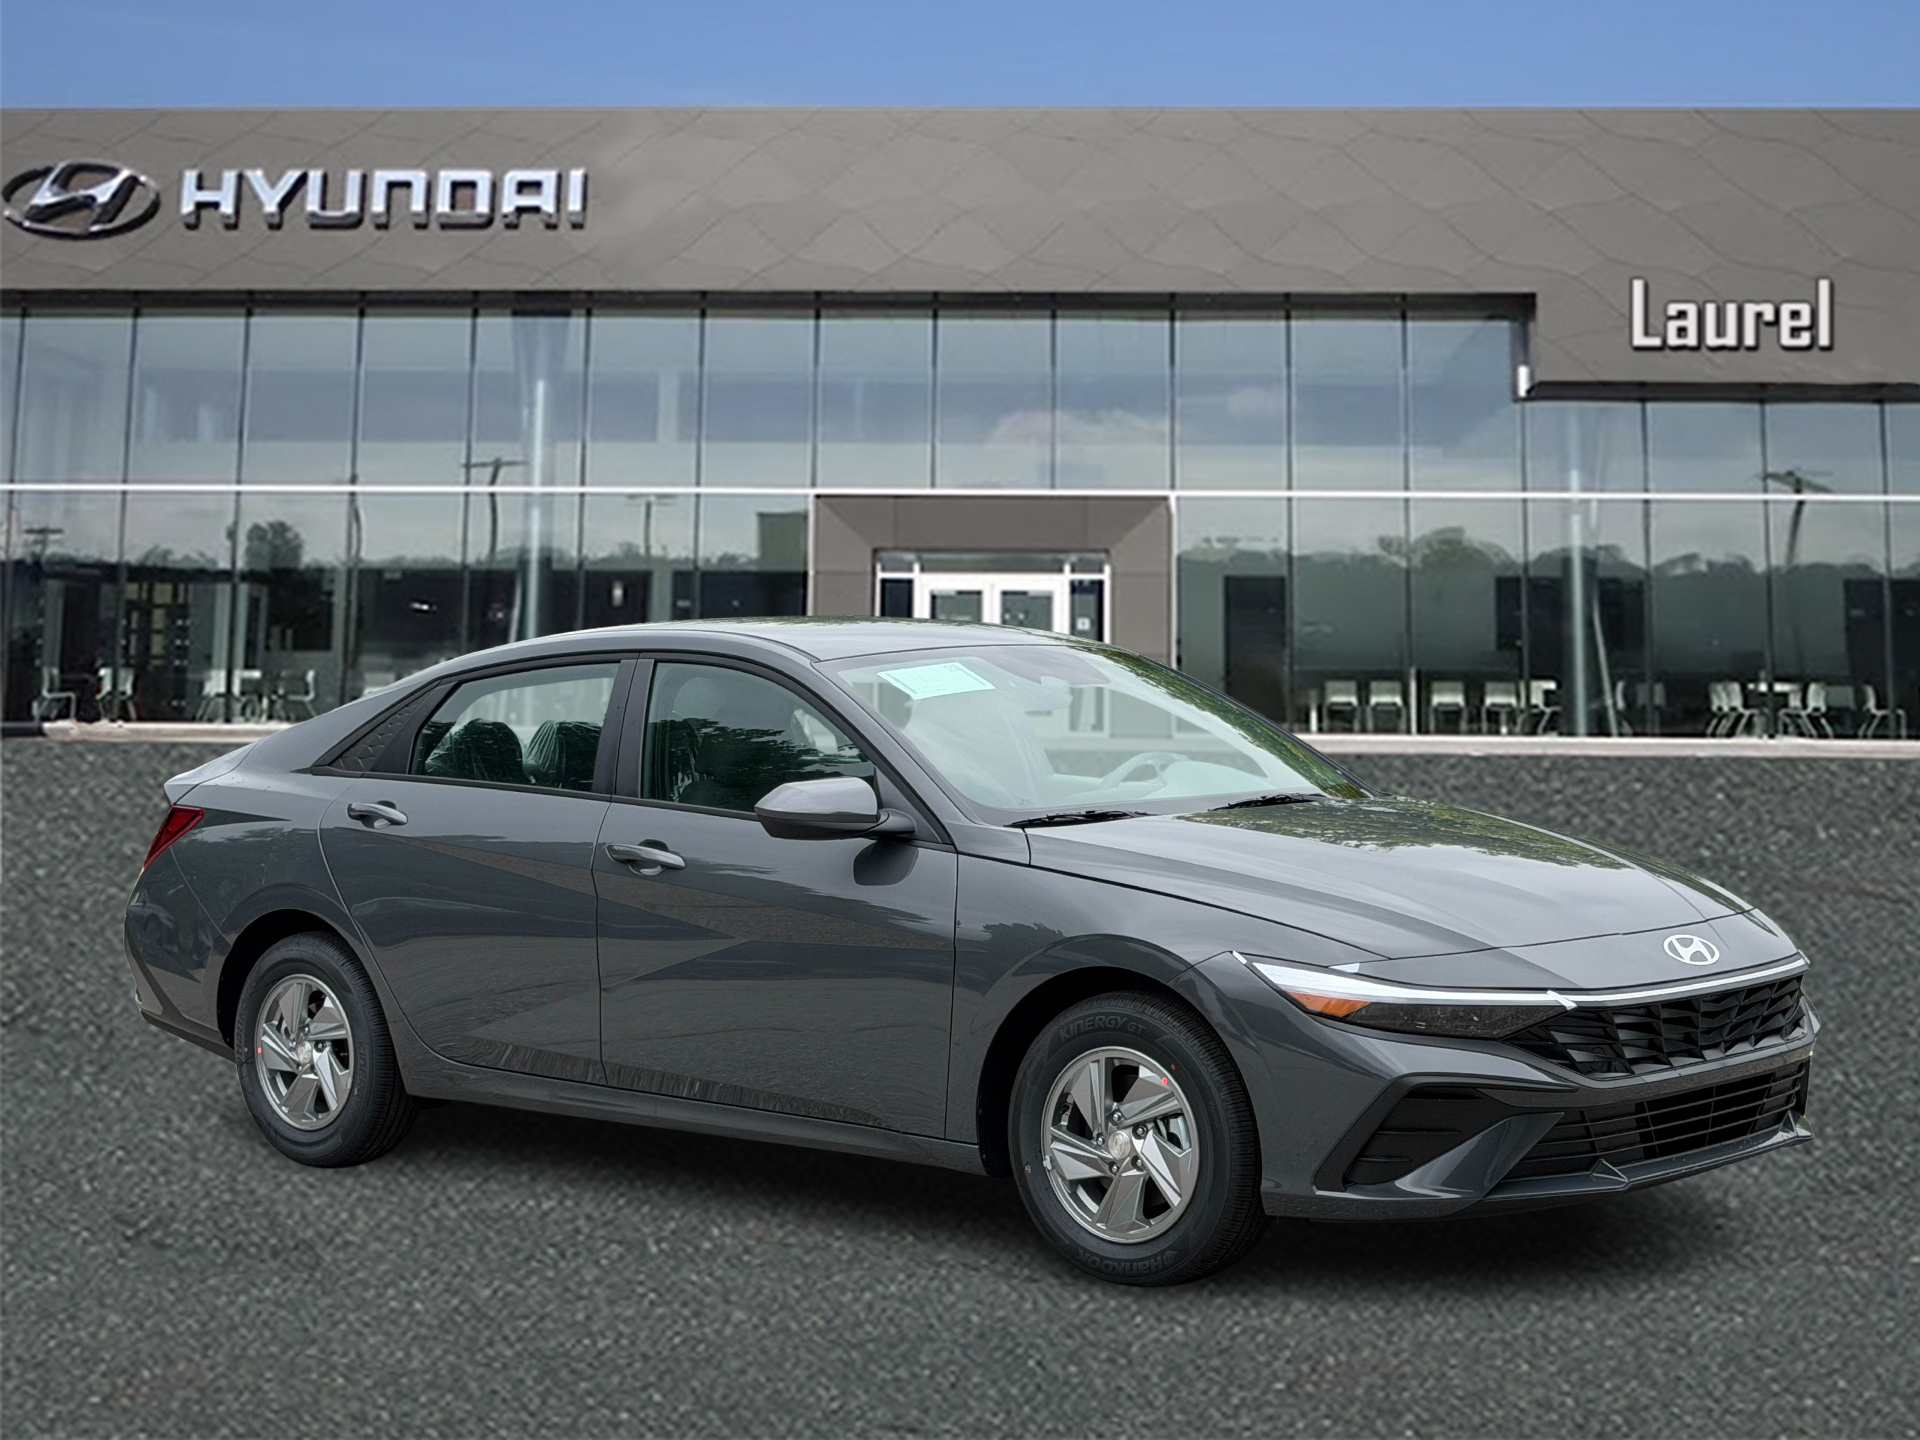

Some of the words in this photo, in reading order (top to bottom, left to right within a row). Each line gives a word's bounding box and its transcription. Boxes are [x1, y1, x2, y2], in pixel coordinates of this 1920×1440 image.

[180, 168, 588, 230] HYUNDAI
[1630, 278, 1834, 350] Laurel
[1059, 1015, 1128, 1043] KINERGY
[1127, 1022, 1146, 1035] GT
